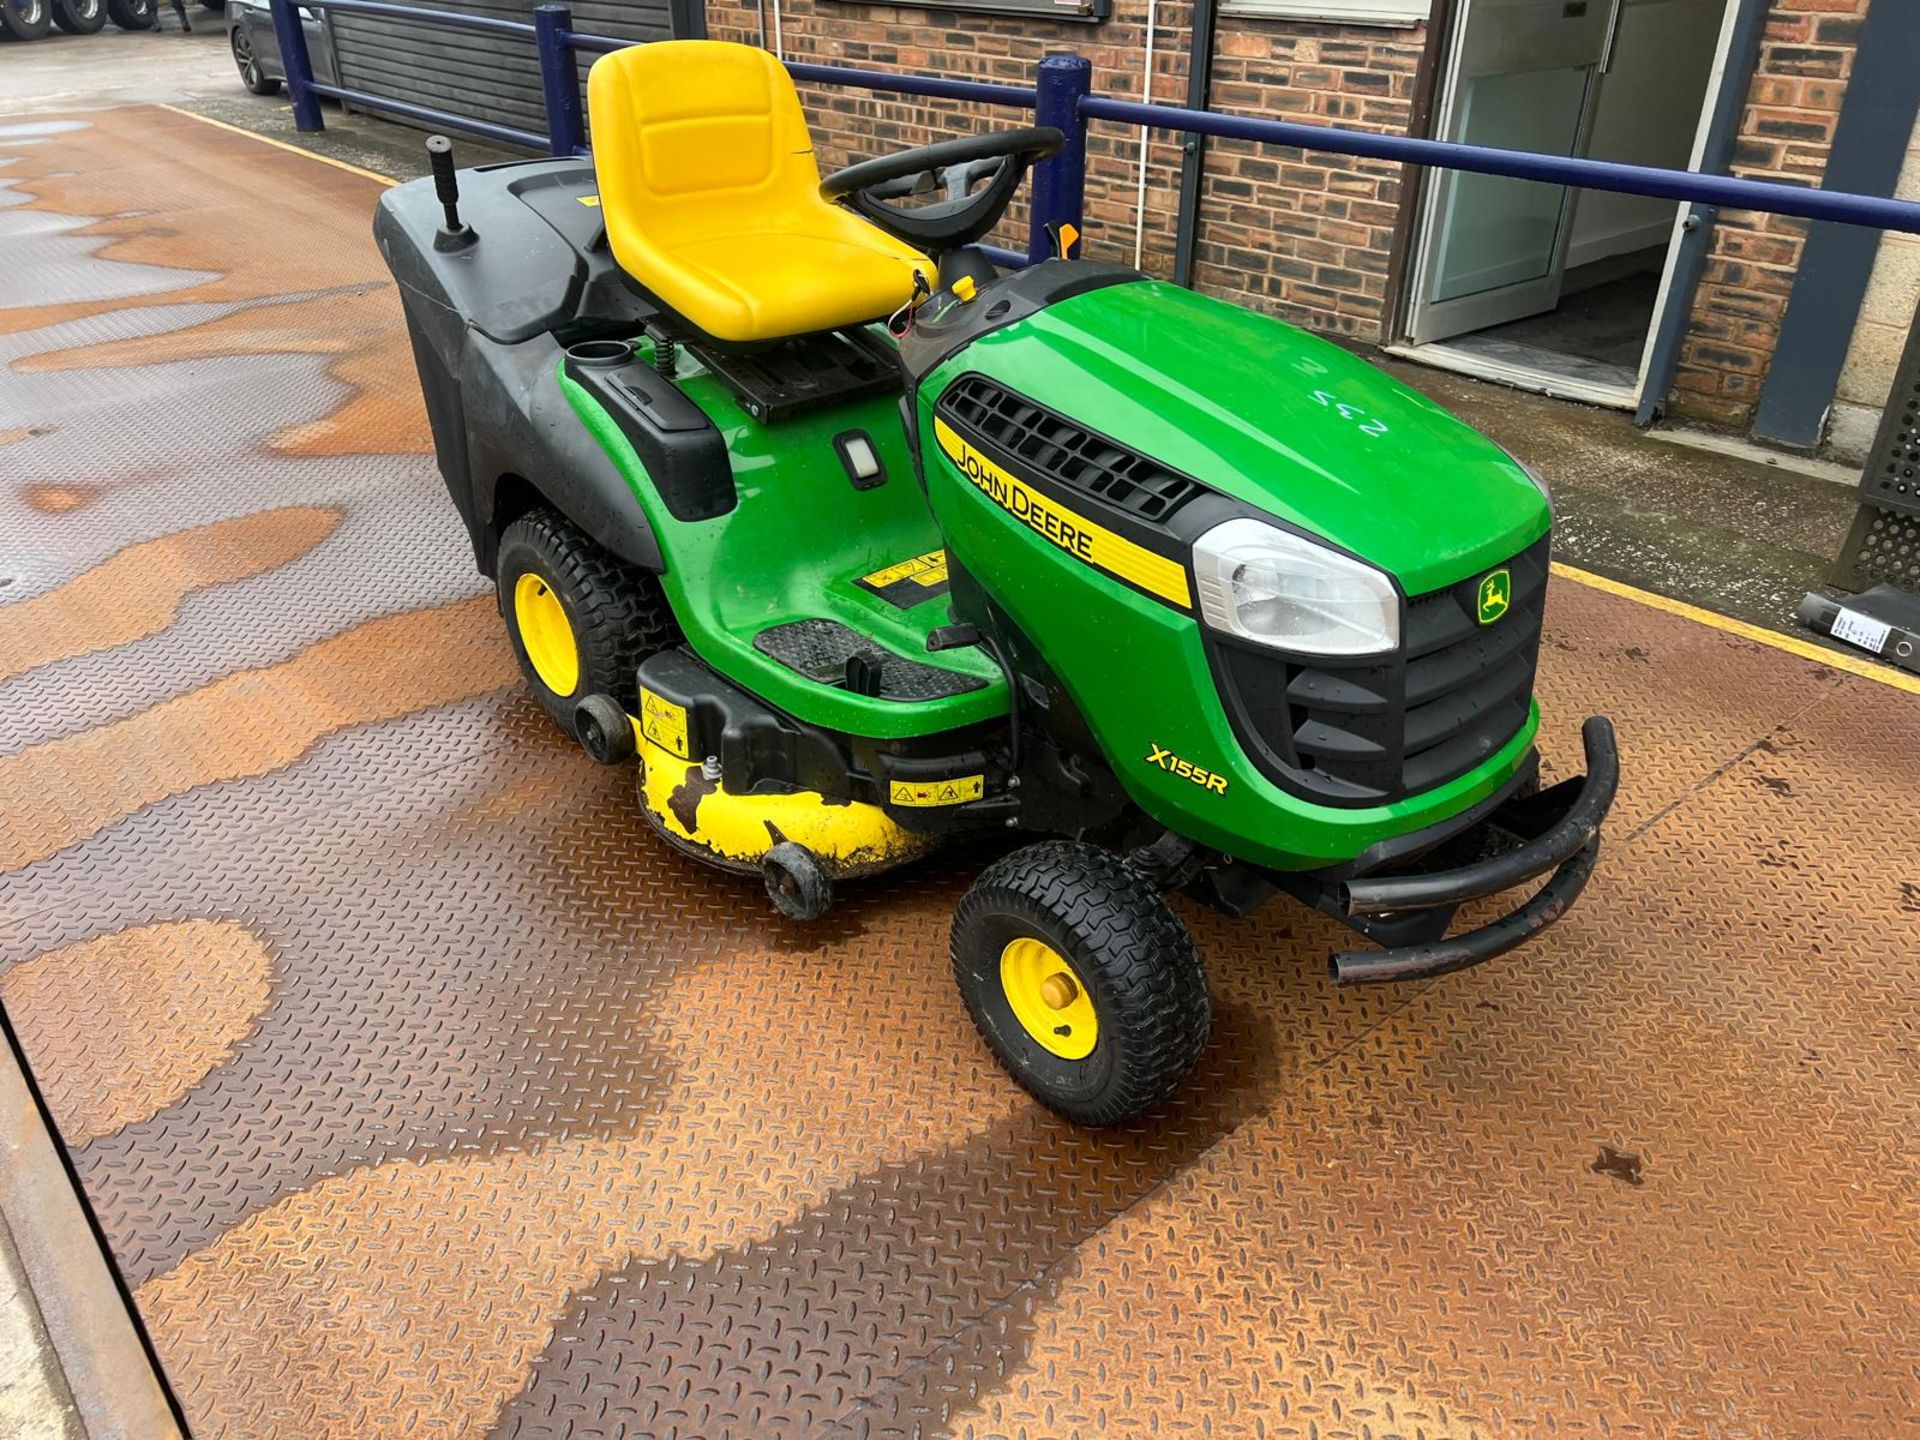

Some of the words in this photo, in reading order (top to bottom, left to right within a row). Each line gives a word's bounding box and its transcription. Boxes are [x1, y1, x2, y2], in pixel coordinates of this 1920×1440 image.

[957, 444, 1008, 505] JOHN
[1012, 485, 1093, 559] DEERE
[1145, 743, 1229, 795] X155R
